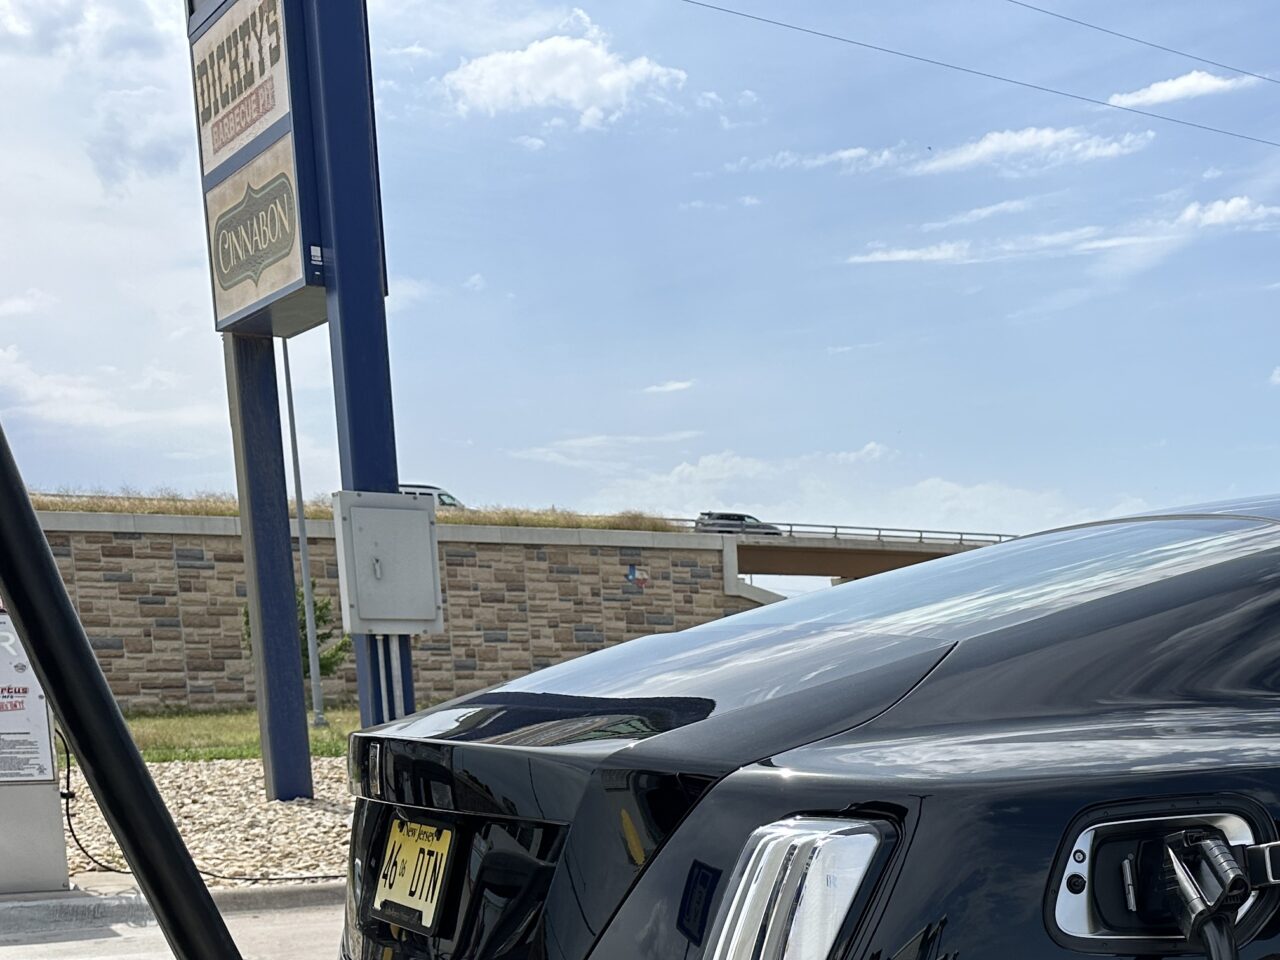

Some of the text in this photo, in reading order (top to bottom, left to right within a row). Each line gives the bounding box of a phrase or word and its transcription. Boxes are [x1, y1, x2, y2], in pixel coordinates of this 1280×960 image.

[213, 92, 258, 150] BARBECUE
[219, 194, 290, 274] CINNABON
[402, 821, 435, 847] New Jersey
[382, 840, 402, 890] 46
[408, 848, 444, 904] DTN
